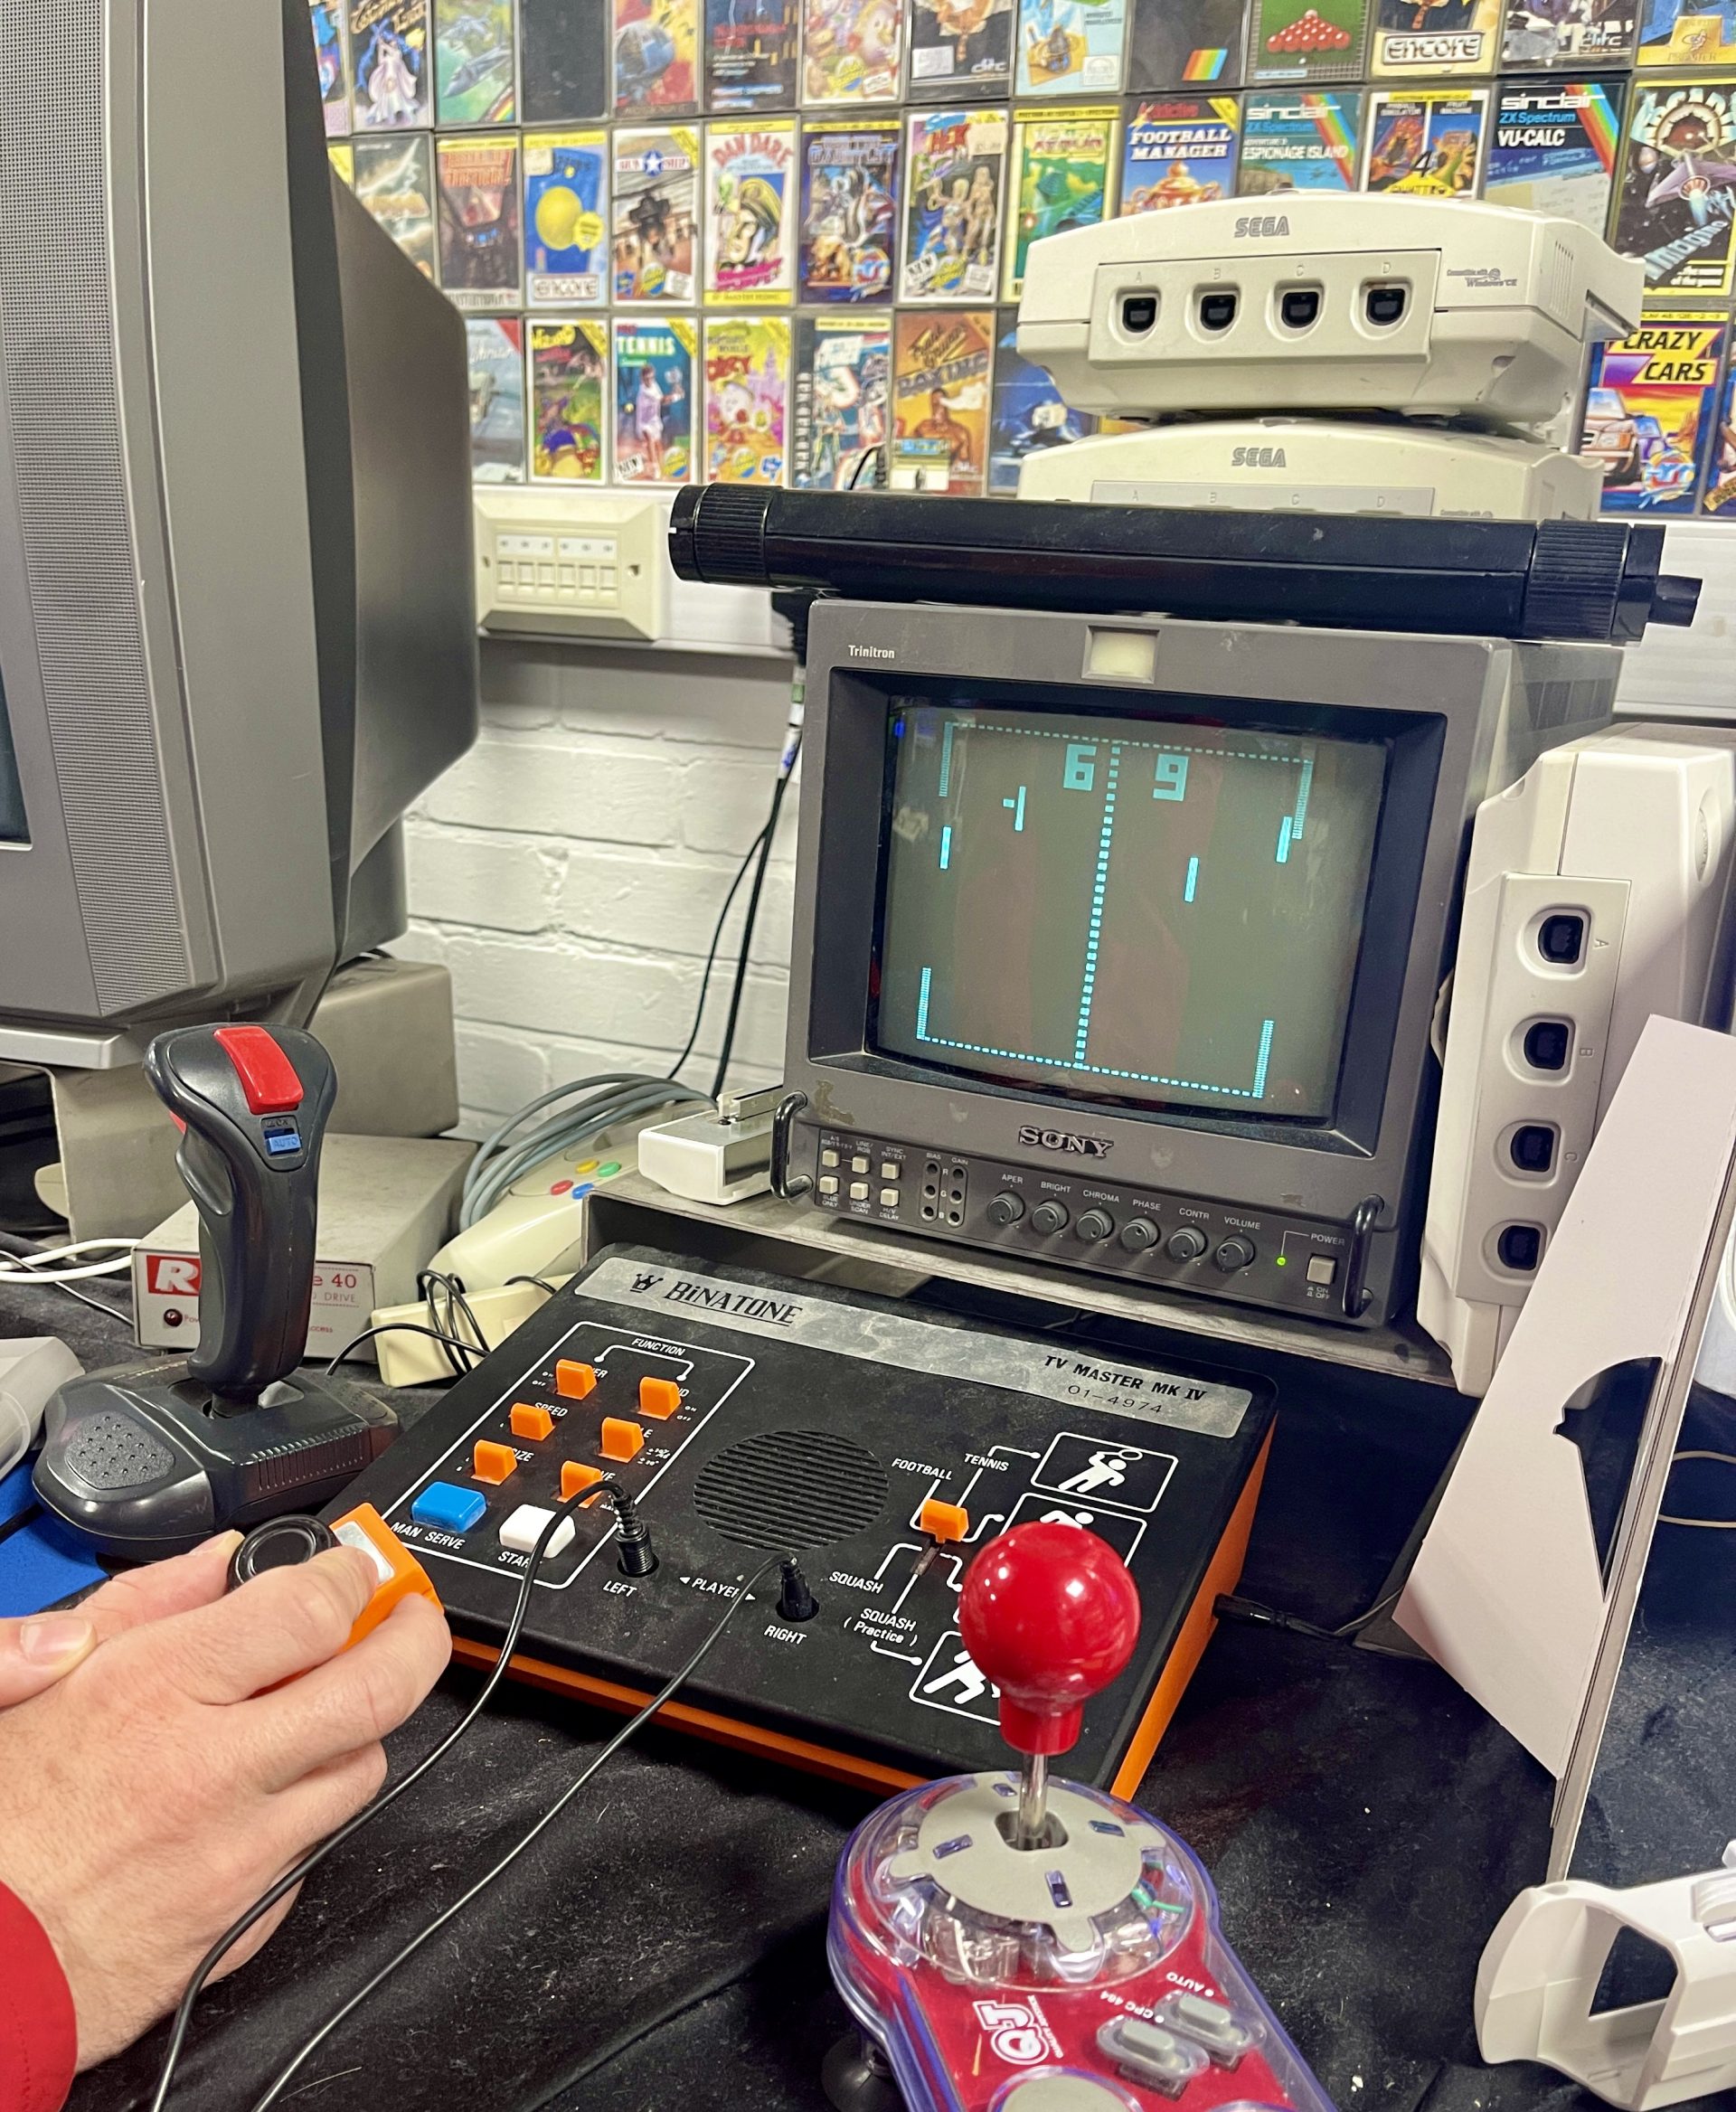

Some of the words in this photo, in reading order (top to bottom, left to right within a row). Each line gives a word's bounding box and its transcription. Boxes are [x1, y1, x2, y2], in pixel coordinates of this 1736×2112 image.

[1500, 90, 1606, 110] sinclair
[1247, 104, 1342, 120] sinclair
[1499, 112, 1516, 124] ZX
[1517, 112, 1576, 125] Spectrum
[1128, 128, 1232, 145] FOOTBALL
[1497, 129, 1566, 146] VU-CALC
[1130, 145, 1228, 161] MANAGER
[1234, 216, 1289, 238] SEGA
[618, 336, 675, 356] TENNIS
[1623, 332, 1702, 350] CRAZY
[1645, 362, 1706, 381] CARS
[1231, 447, 1287, 468] SEGA
[848, 645, 895, 658] Trinitron
[1063, 743, 1097, 791] 6
[1153, 753, 1189, 801] 9
[886, 1146, 904, 1155] SYNC
[1019, 1126, 1114, 1158] SONY
[926, 1152, 941, 1161] BIAS
[951, 1156, 968, 1165] GAIN
[942, 1168, 948, 1176] R
[1001, 1174, 1024, 1183] APER
[940, 1190, 947, 1198] G
[1041, 1181, 1071, 1193] BRIGHT
[1082, 1189, 1119, 1202] CHROMA
[822, 1201, 838, 1209] ONLY
[850, 1206, 868, 1214] SCAN
[1132, 1199, 1161, 1211] PHASE
[879, 1212, 899, 1221] DELAY
[939, 1212, 945, 1220] B
[1179, 1208, 1210, 1220] CONTR
[1224, 1216, 1260, 1230] VOLUME
[1311, 1232, 1345, 1246] POWER
[331, 1274, 357, 1288] 40
[325, 1292, 356, 1303] DRIVE
[631, 1338, 685, 1356] FUNCTION
[1044, 1355, 1069, 1369] TV
[1072, 1363, 1143, 1391] MASTER
[1151, 1381, 1181, 1397] MK
[1184, 1387, 1208, 1400] IV
[892, 1457, 953, 1480] FOOTBALL
[964, 1453, 1009, 1472] TENNIS
[390, 1522, 420, 1538] MAN
[424, 1532, 466, 1550] SERVE
[497, 1551, 531, 1569] STAR
[602, 1580, 637, 1598] LEFT
[828, 1570, 884, 1594] SQUASH
[860, 1608, 917, 1632] SQUASH
[763, 1625, 807, 1645] RIGHT
[854, 1620, 904, 1644] Practice
[1165, 1971, 1205, 1993] AUTO
[1124, 2001, 1155, 2021] CPC
